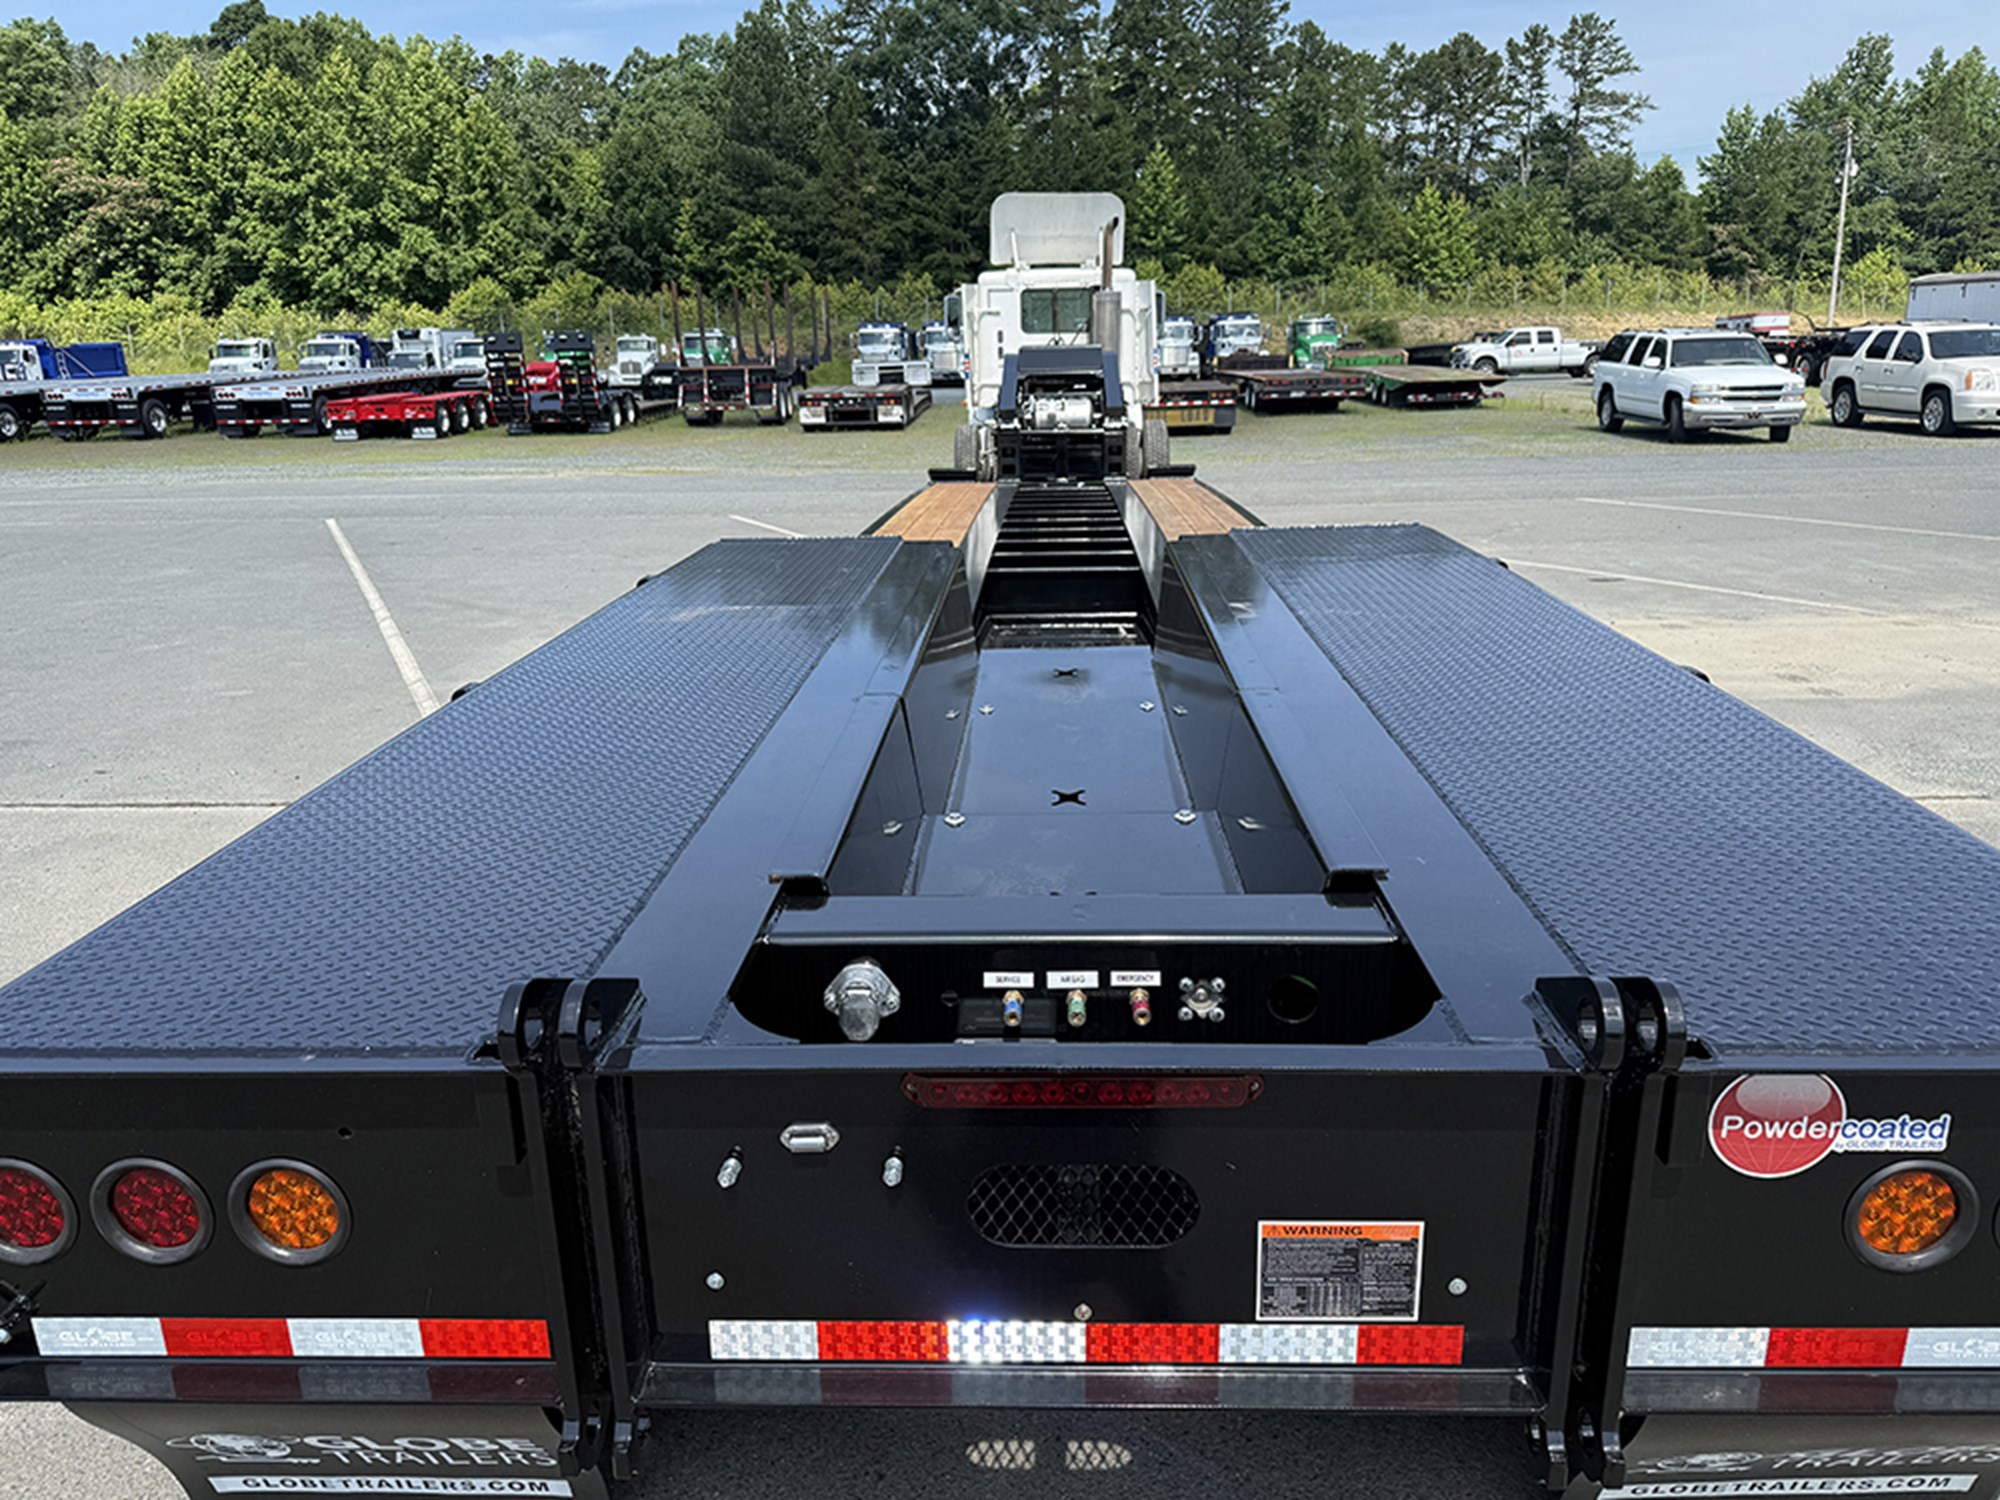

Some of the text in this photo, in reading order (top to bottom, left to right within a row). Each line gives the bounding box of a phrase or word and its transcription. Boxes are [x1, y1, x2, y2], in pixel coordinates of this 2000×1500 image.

[995, 975, 1021, 984] SERVICE
[1116, 973, 1154, 983] EMERGENCY
[1845, 1140, 1886, 1149] GLOBE
[1889, 1140, 1944, 1149] TRAILERS
[1284, 1225, 1363, 1236] WARNING
[303, 1434, 539, 1452] GLOBE
[320, 1449, 558, 1467] TRAILERS
[242, 1476, 551, 1493] GLOBETRAILERS.COM
[1630, 1476, 1953, 1496] GLOBETRAILERS.COM
